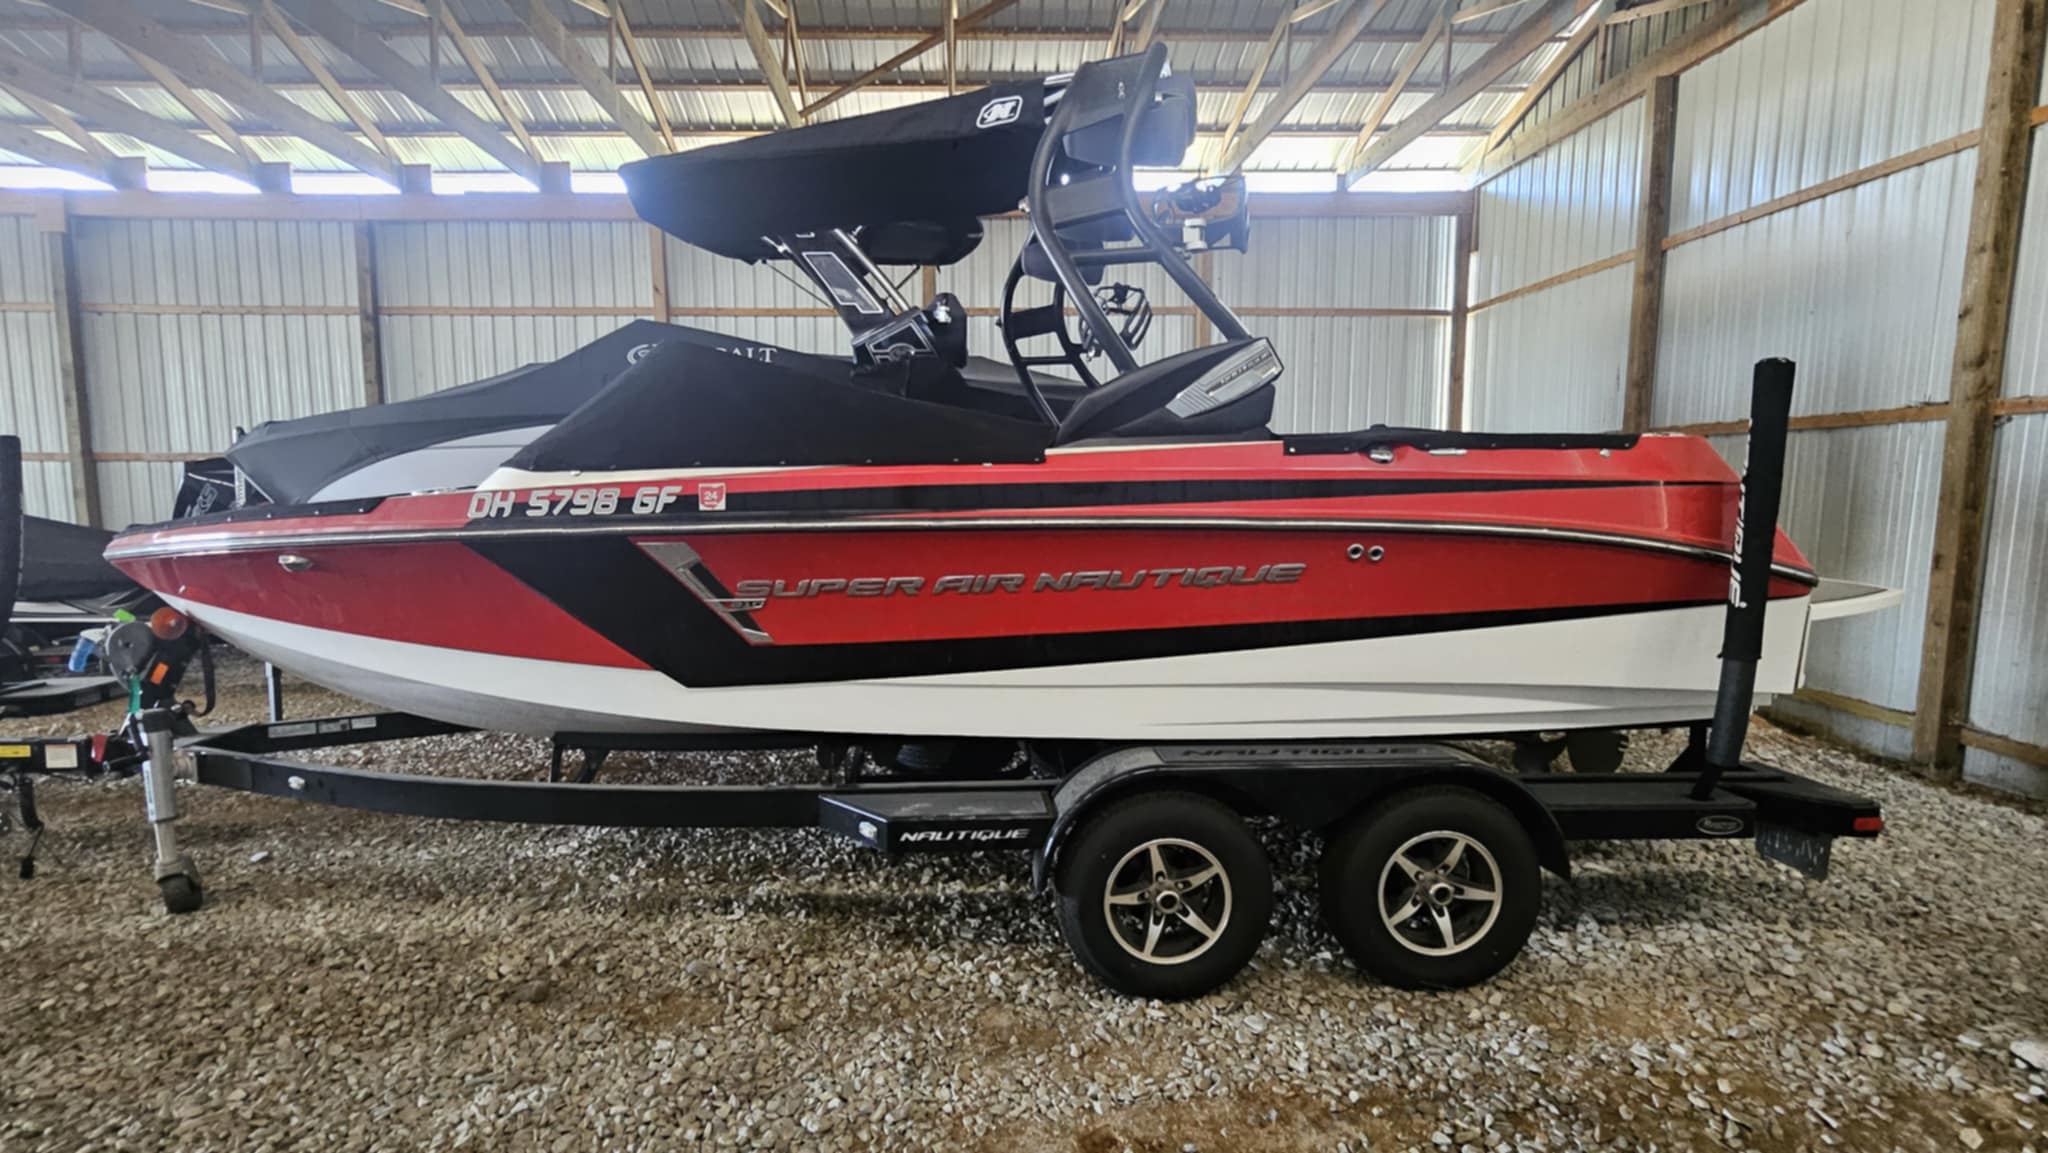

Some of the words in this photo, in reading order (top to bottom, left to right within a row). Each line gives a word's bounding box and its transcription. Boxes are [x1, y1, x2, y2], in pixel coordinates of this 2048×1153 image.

[467, 490, 516, 519] OH
[525, 486, 621, 516] 5798
[631, 485, 683, 514] GF
[735, 577, 925, 598] SUPER
[932, 574, 1025, 594] AIR
[1032, 563, 1307, 592] NAUTIQUE
[900, 828, 1031, 842] NAUTIQUE
